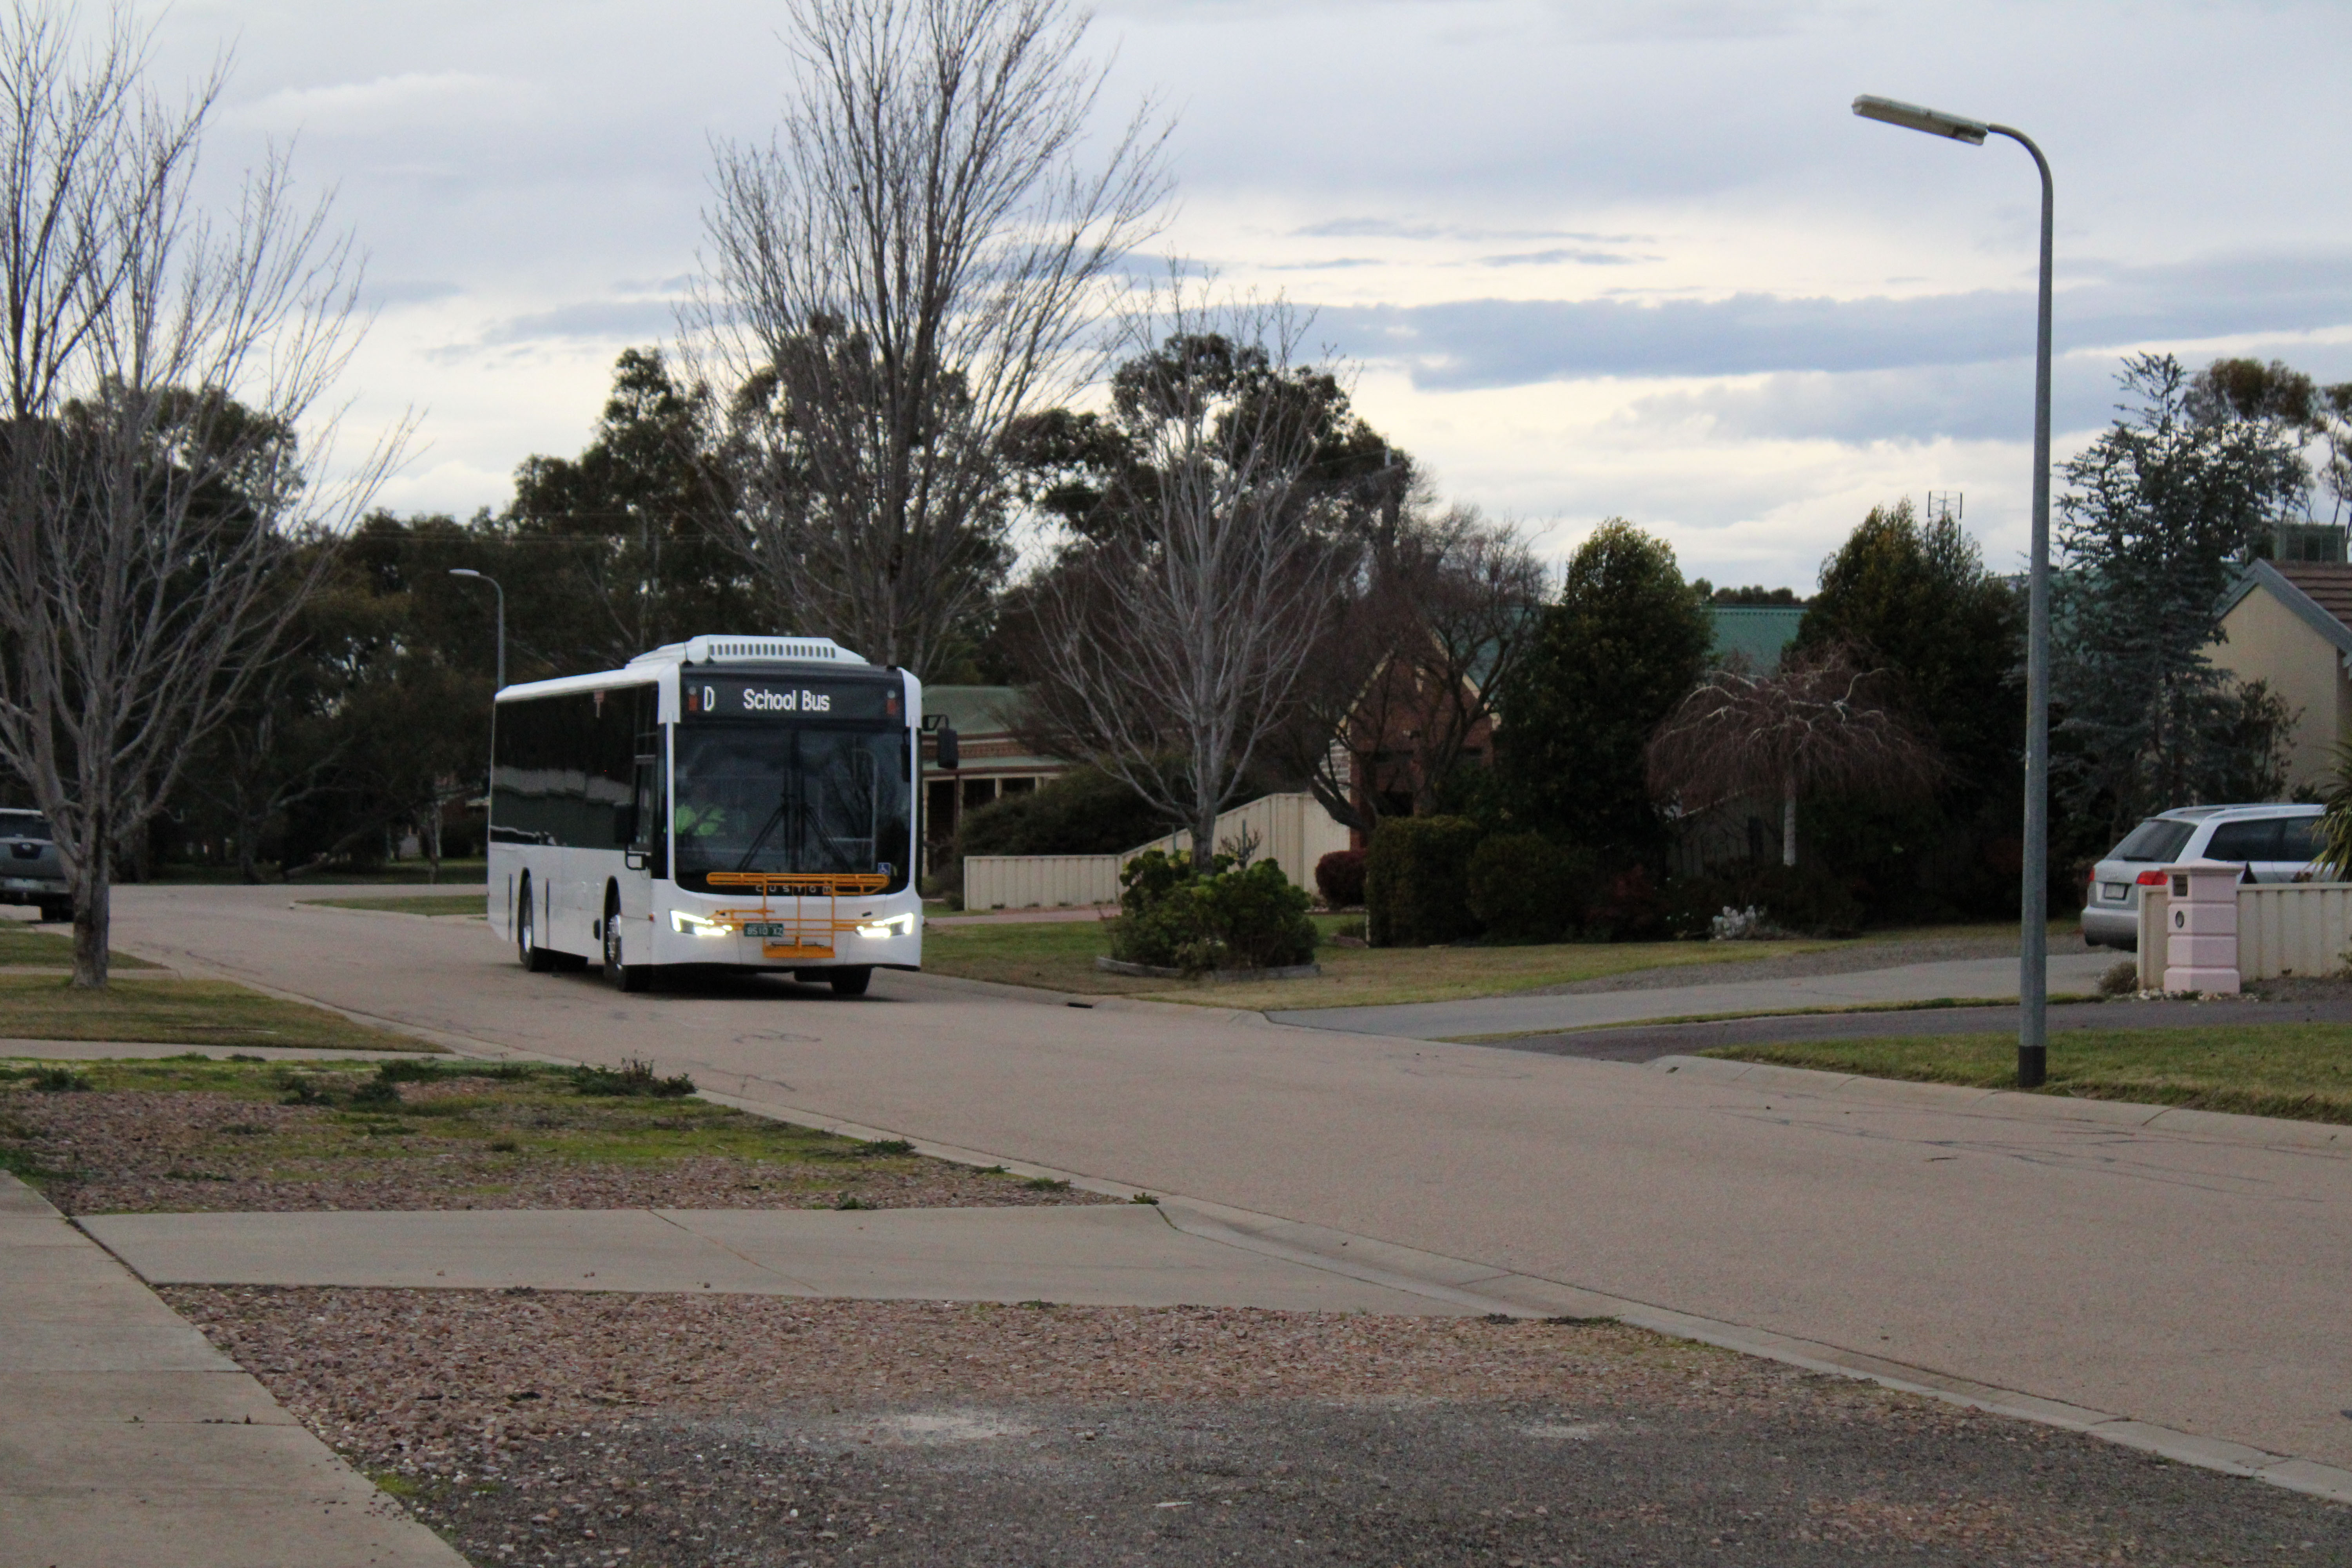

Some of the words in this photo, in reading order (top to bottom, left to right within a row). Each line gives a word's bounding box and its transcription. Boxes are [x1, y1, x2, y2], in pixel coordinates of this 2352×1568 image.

[704, 686, 715, 711] D
[744, 688, 797, 710] School
[802, 690, 830, 711] Bus
